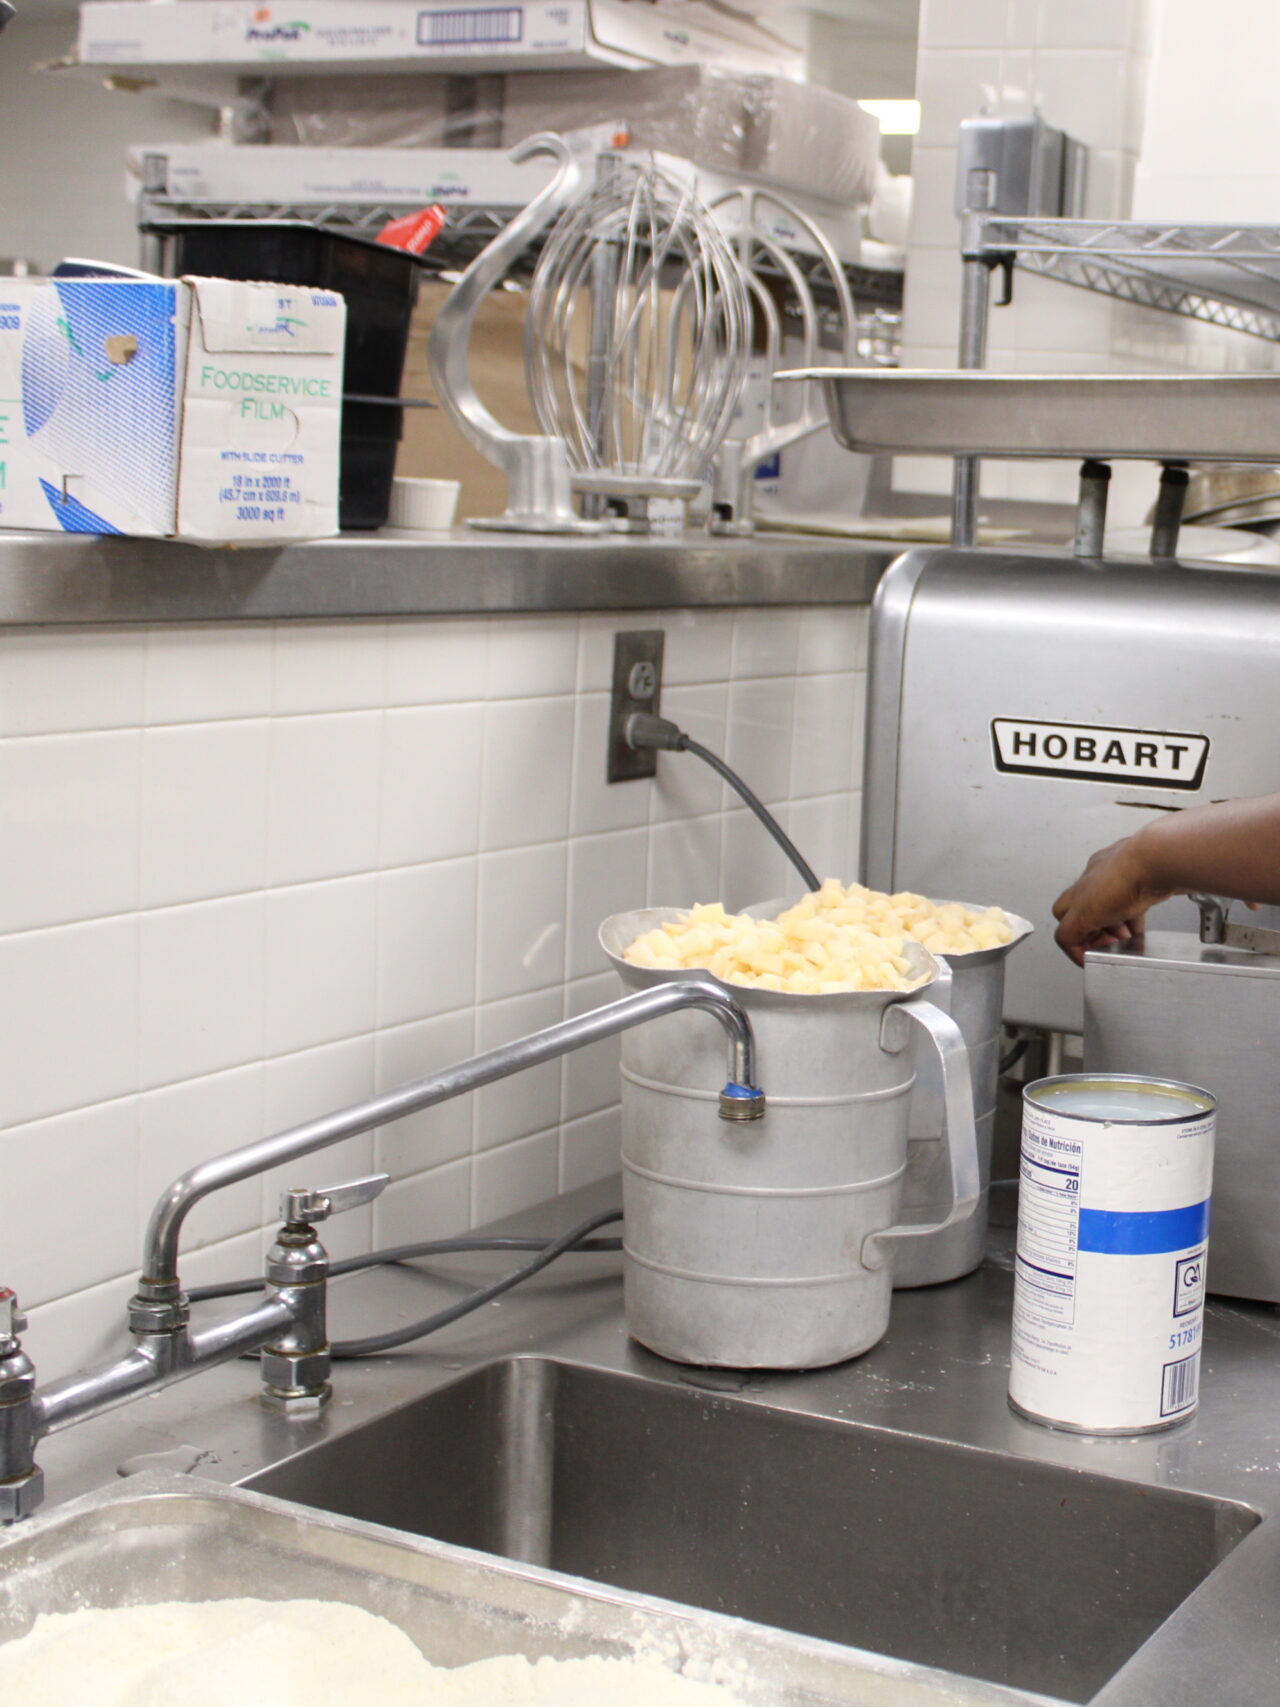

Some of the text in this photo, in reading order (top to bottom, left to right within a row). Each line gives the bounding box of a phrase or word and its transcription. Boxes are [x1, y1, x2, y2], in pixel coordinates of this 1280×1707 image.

[201, 365, 332, 397] FOODSERVICE
[241, 397, 285, 420] FILM
[1012, 731, 1190, 771] HOBART
[1066, 1178, 1079, 1191] 20
